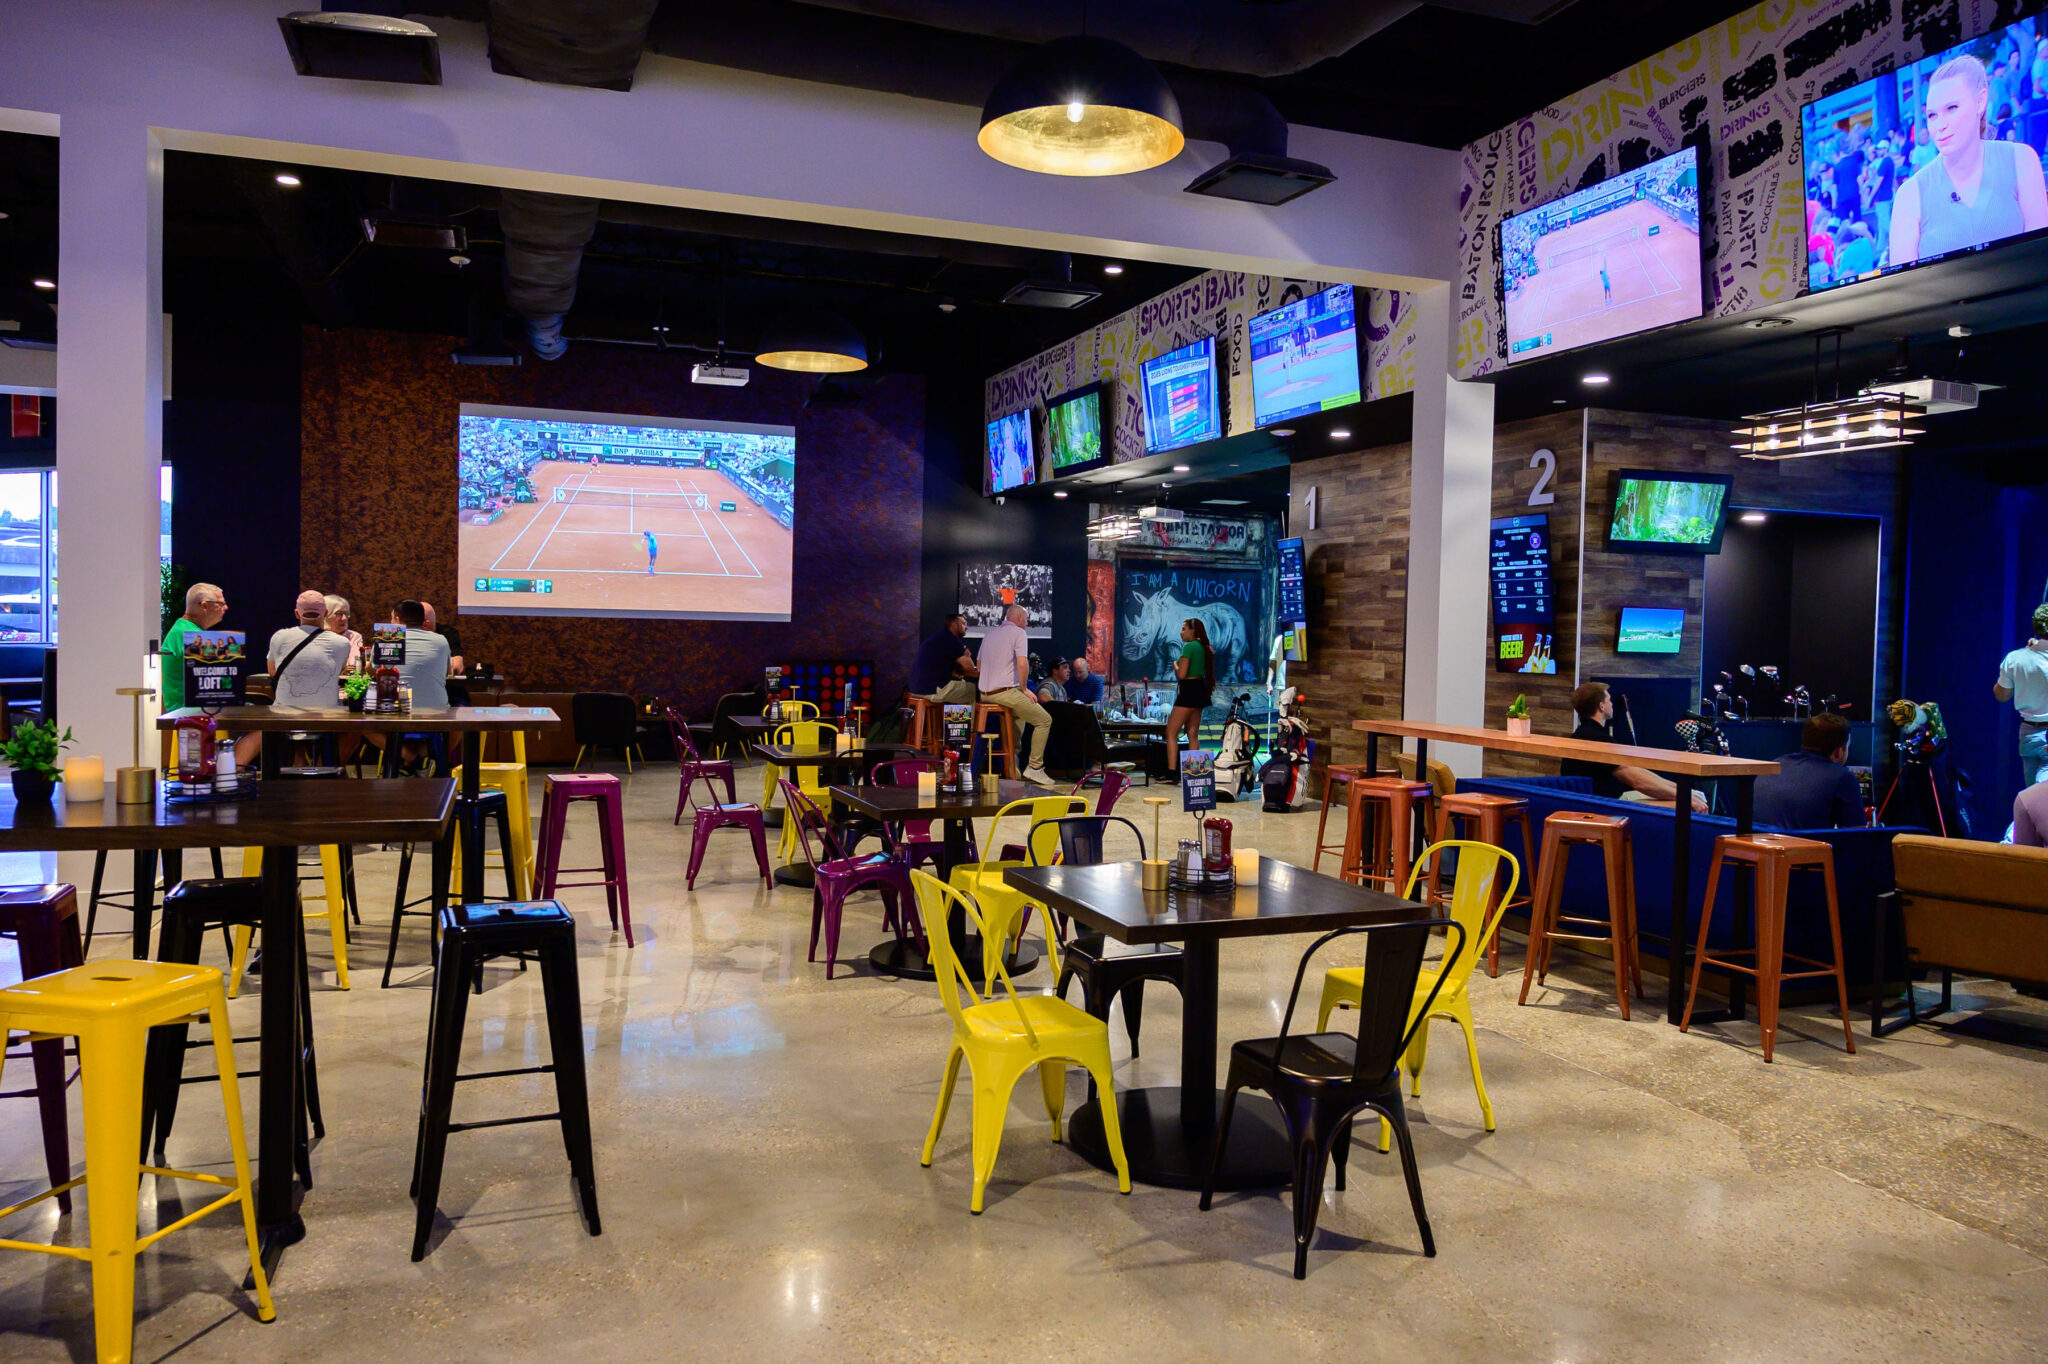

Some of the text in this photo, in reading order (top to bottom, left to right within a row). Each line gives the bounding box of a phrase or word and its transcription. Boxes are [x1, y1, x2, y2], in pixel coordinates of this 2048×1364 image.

[1658, 72, 1706, 110] BURGERS
[1646, 105, 1676, 148] BURGERS
[1720, 101, 1770, 141] DRINKS
[1720, 190, 1733, 235] PARTY
[1760, 172, 1780, 234] COCKTAILS
[1737, 188, 1758, 269] PARTY
[1462, 213, 1489, 300] BATON
[1140, 283, 1200, 336] SPORTS
[1204, 272, 1246, 311] BAR
[1038, 345, 1068, 370] BURGERS
[1231, 313, 1243, 377] FOOD
[991, 365, 1038, 412] DRINKS
[635, 449, 664, 457] PARIBAS
[1527, 448, 1557, 507] 2
[1304, 486, 1316, 530] 1
[1148, 573, 1163, 588] AM
[1171, 571, 1178, 587] A
[1186, 577, 1251, 602] UNICORN
[193, 666, 238, 676] WELCOME TO
[1500, 640, 1524, 659] BEER!
[198, 676, 233, 690] LOFT18
[1187, 779, 1206, 787] WELCOME
